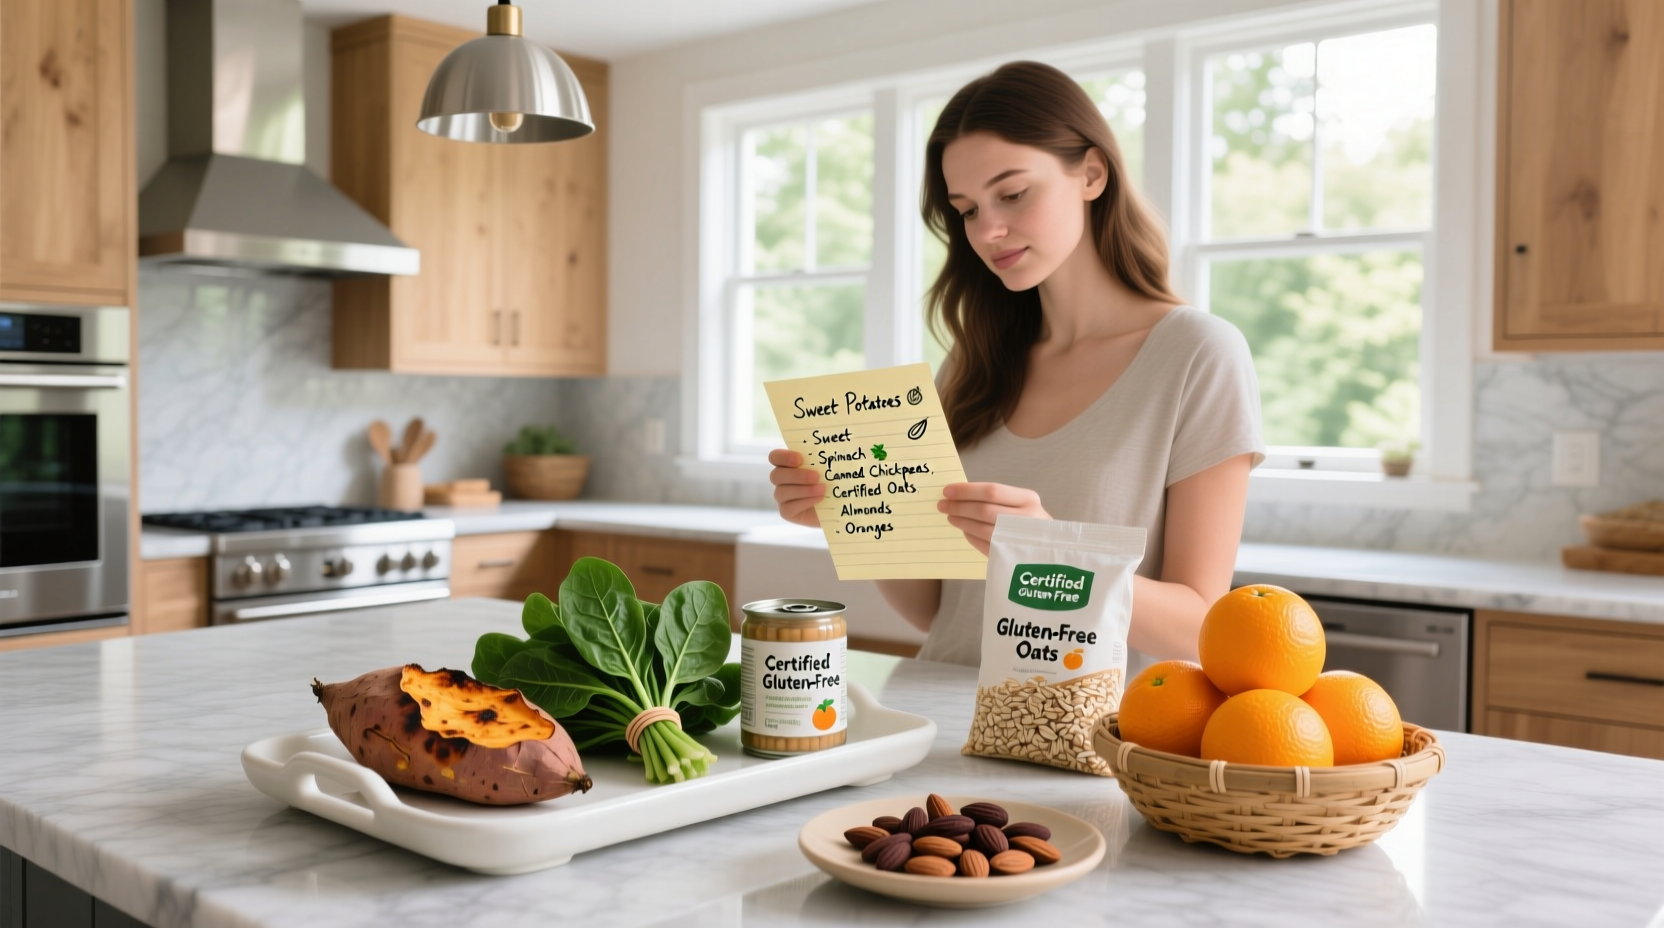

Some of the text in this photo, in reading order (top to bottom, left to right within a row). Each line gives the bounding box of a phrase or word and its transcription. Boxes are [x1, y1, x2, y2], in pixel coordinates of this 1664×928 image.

[793, 396, 839, 419] Sweet
[818, 446, 867, 469] Spinach
[824, 466, 865, 481] Canned
[832, 483, 881, 499] Certified
[840, 500, 892, 517] Almonds
[845, 522, 894, 540] Oranges
[996, 617, 1097, 645] Gluten-Free
[1016, 640, 1059, 662] Oats
[764, 652, 831, 671] Certified
[762, 673, 840, 690] Gluten-Free
